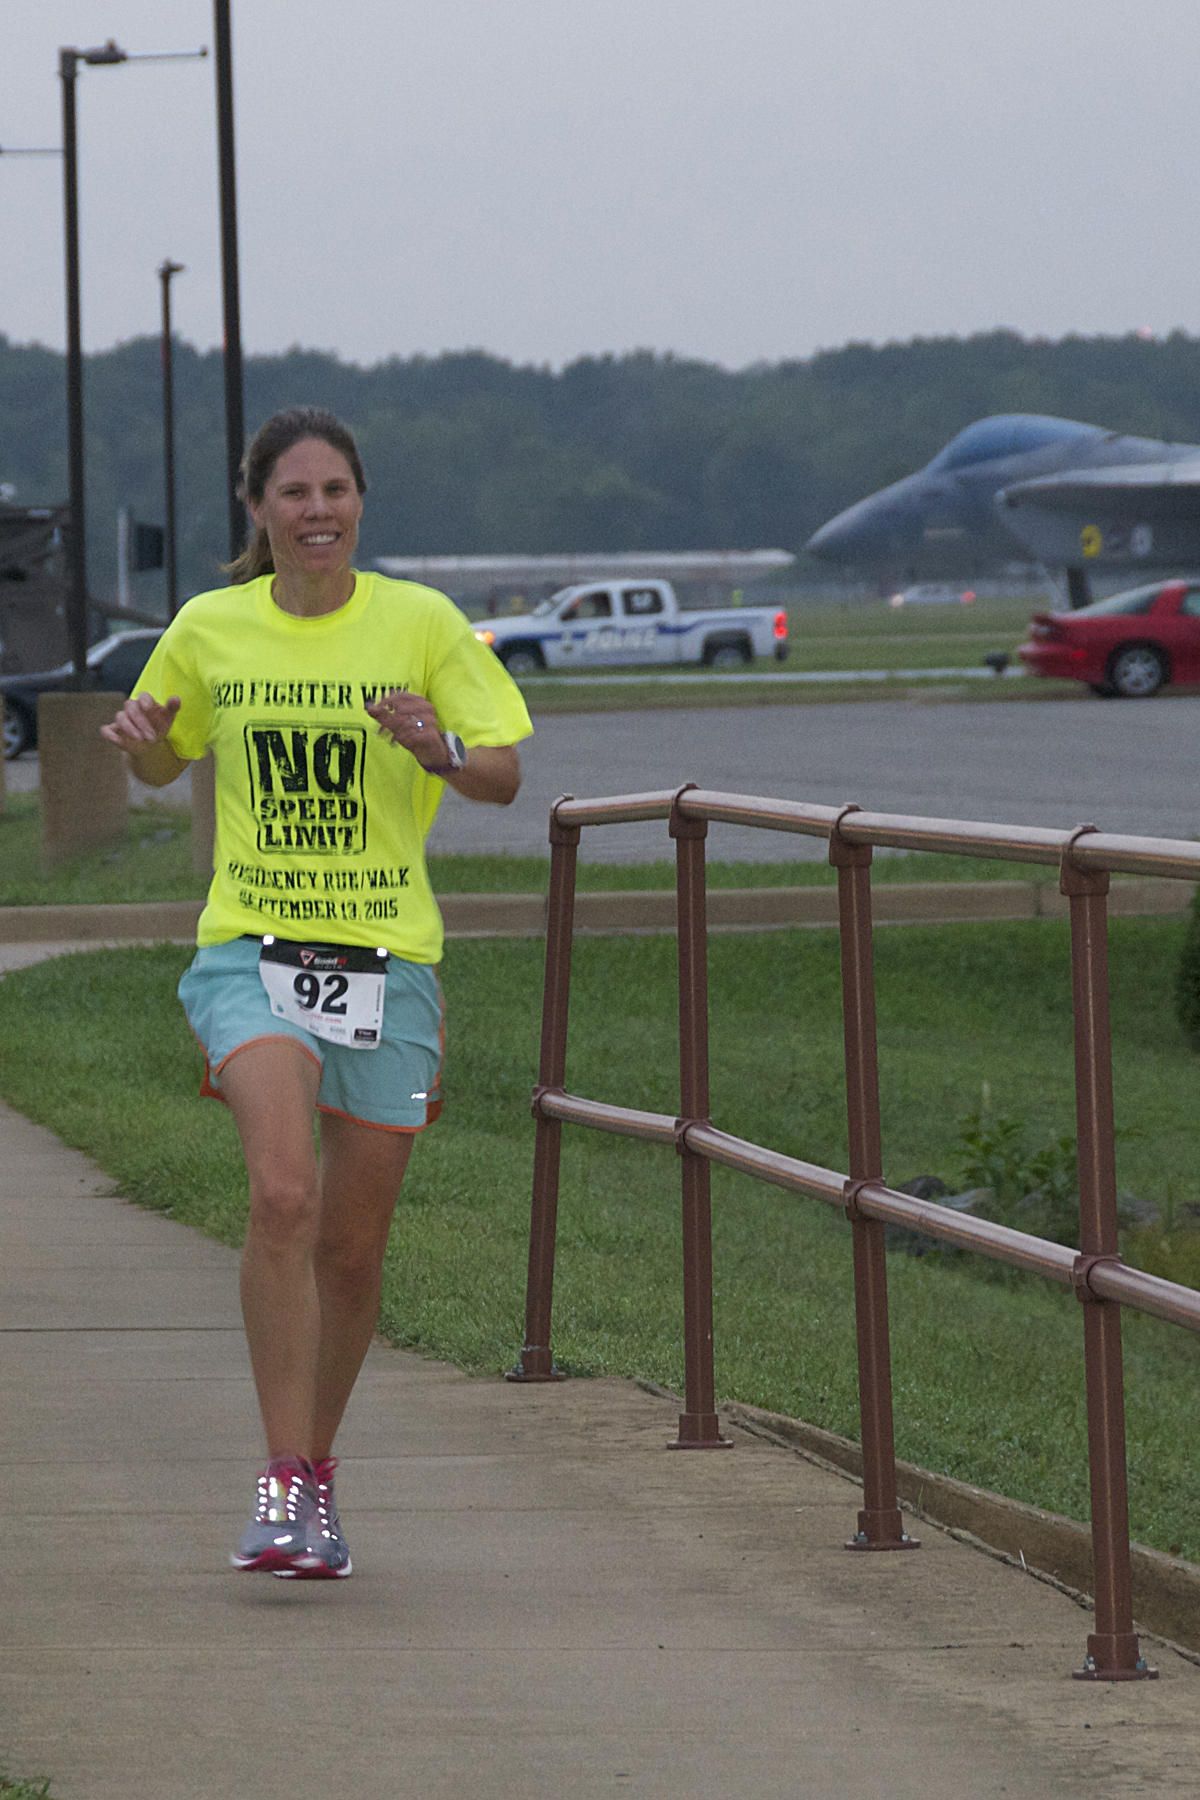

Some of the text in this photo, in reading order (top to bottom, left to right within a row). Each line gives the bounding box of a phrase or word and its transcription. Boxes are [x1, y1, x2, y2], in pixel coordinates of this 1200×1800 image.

[249, 678, 353, 709] FIGHTER
[252, 730, 358, 795] NO
[260, 798, 358, 821] SPEED
[263, 825, 359, 849] LIMIT
[323, 867, 409, 891] RUN/WALK
[239, 889, 337, 920] SEPTEMBER
[364, 897, 398, 920] 2015
[293, 972, 349, 1015] 92
